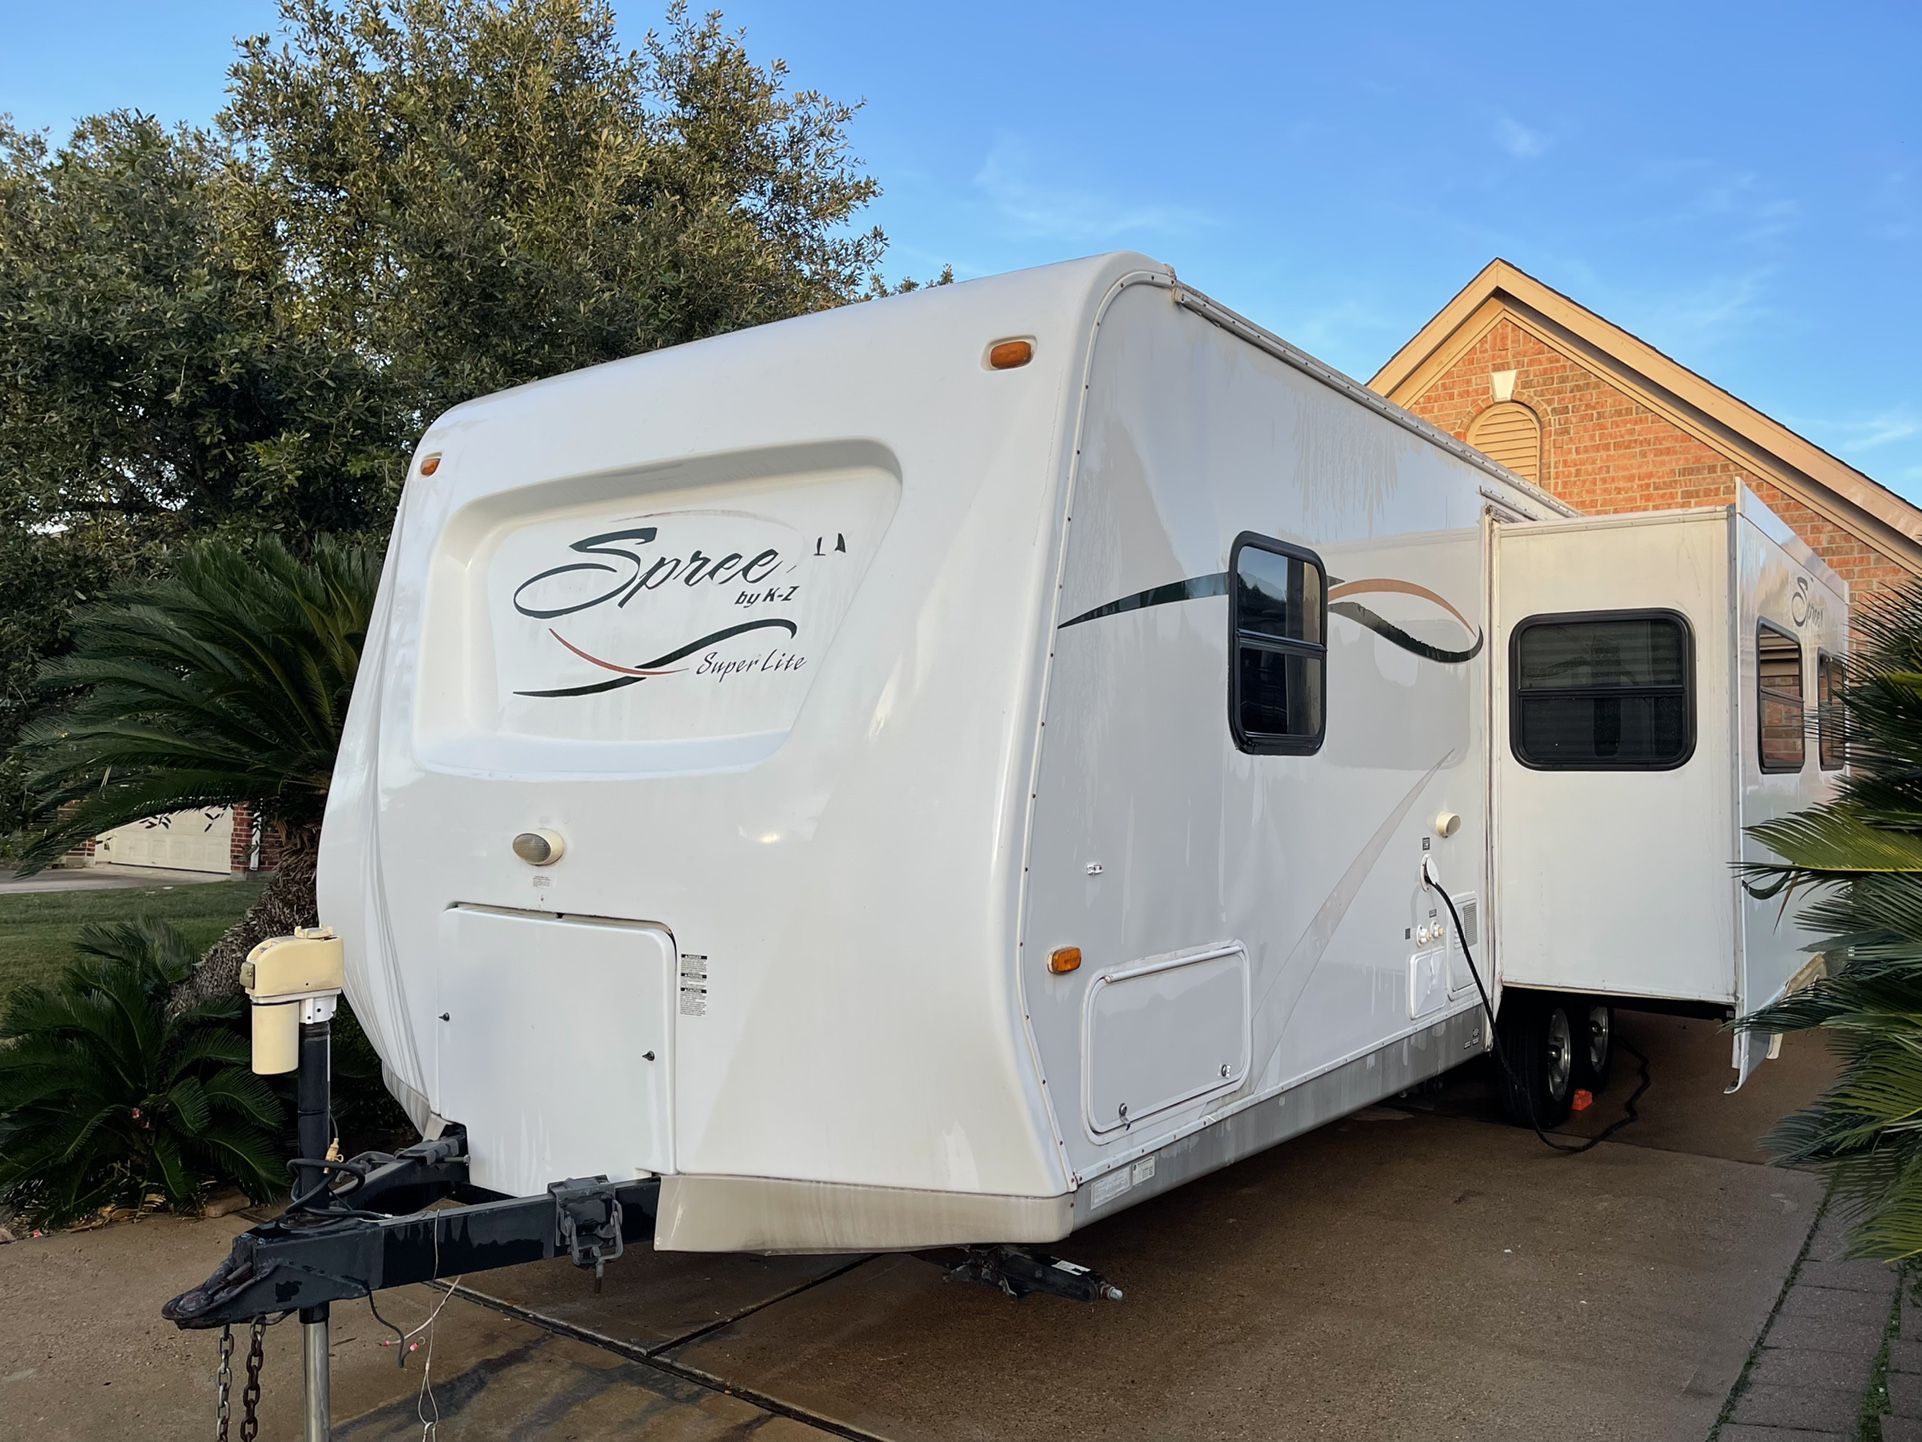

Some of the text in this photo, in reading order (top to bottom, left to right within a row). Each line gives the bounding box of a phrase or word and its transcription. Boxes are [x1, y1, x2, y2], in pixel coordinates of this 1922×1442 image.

[513, 527, 784, 619] Spree
[734, 585, 800, 608] by K-Z
